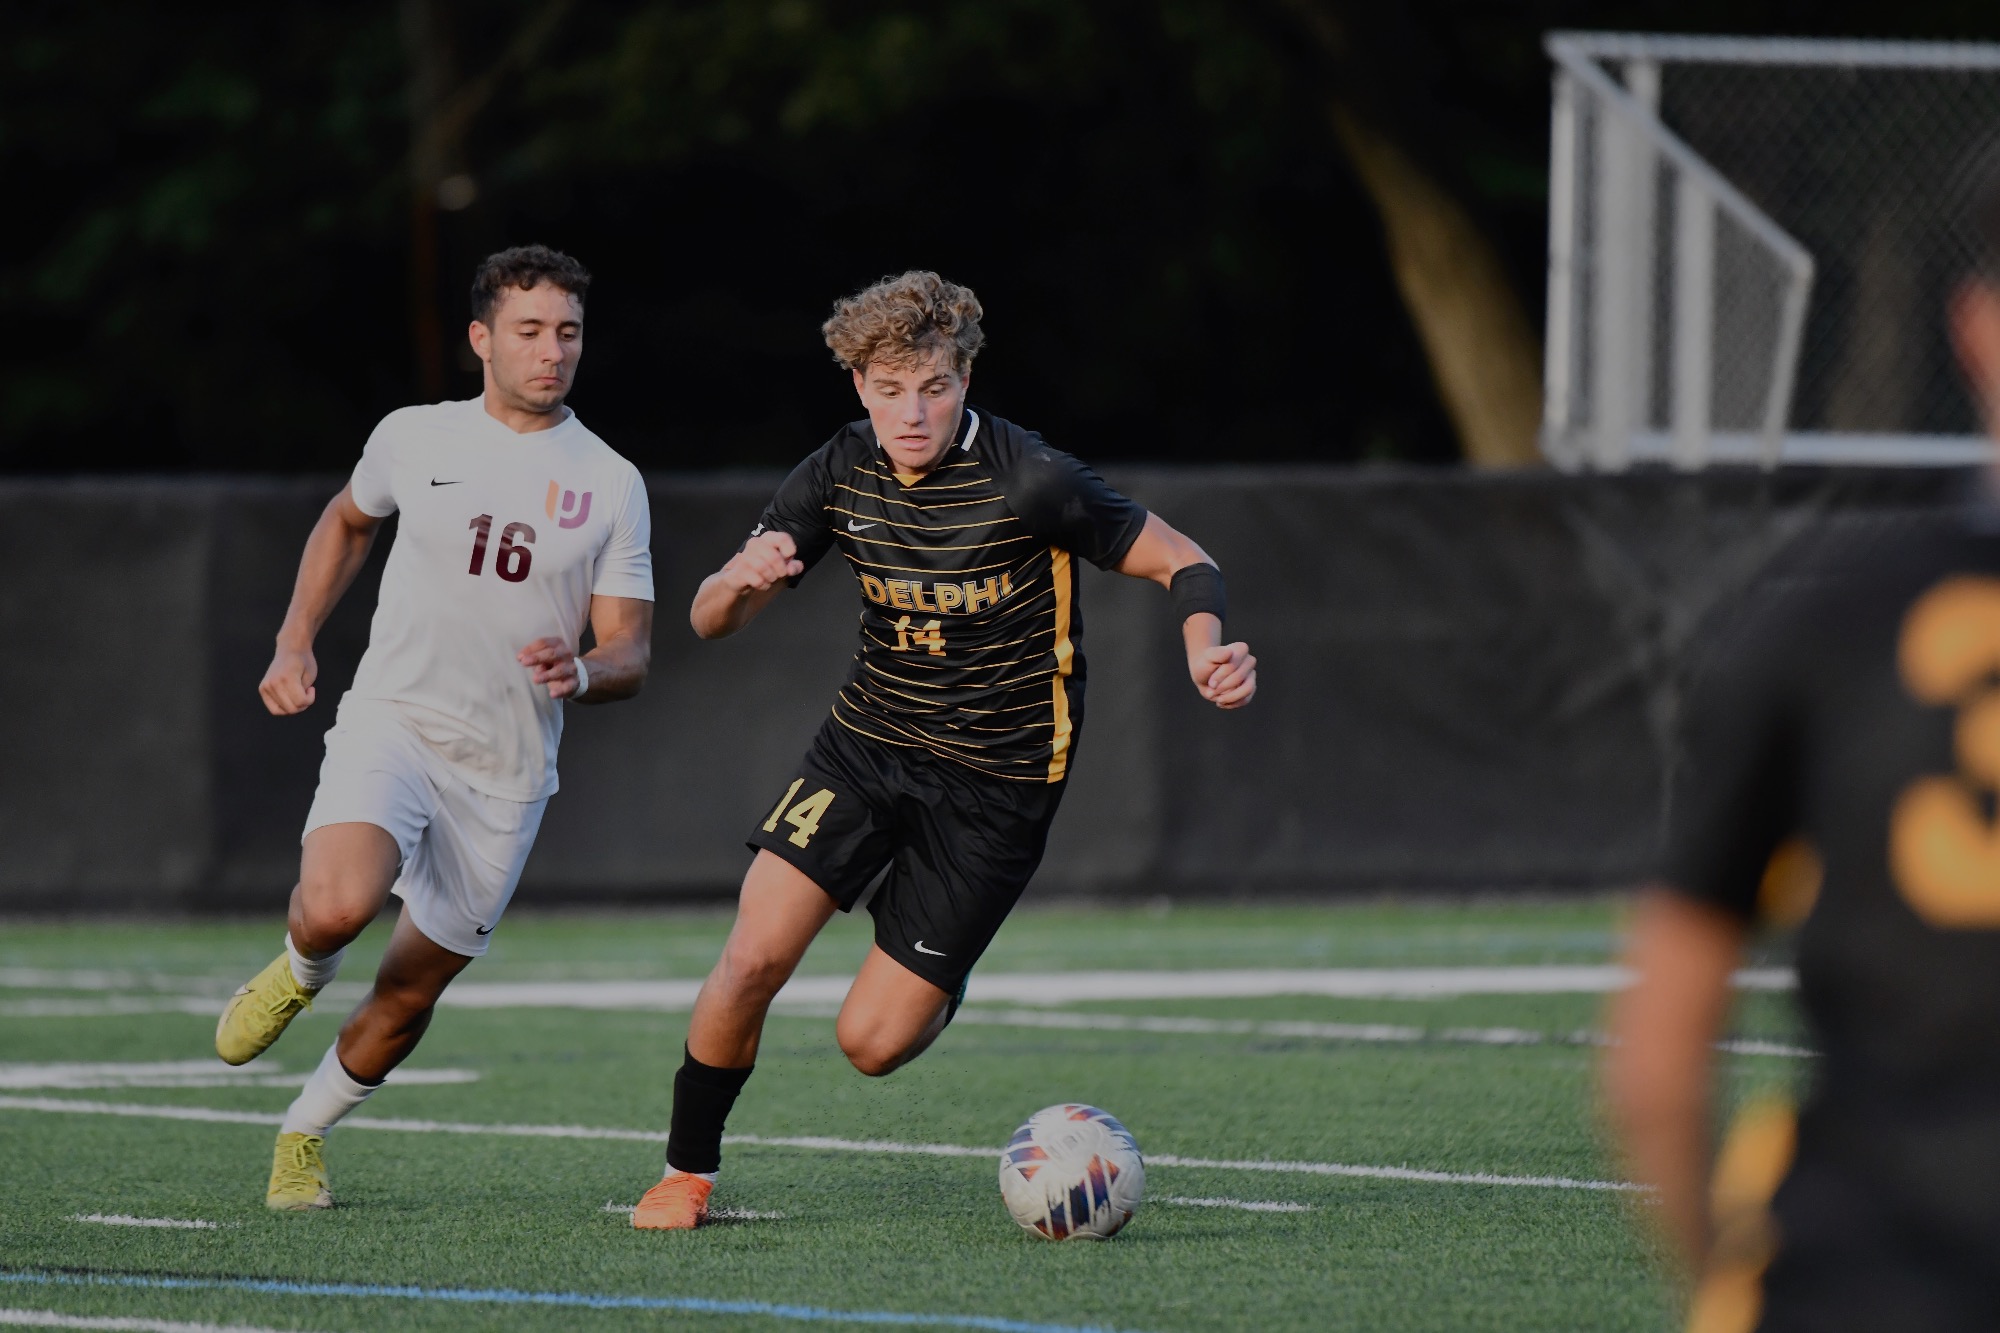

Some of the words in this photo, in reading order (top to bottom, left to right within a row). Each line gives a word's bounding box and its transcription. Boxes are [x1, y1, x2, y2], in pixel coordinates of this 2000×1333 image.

[468, 513, 537, 583] 16
[860, 569, 1014, 615] DELPHI
[890, 615, 947, 657] 14
[762, 777, 836, 849] 14
